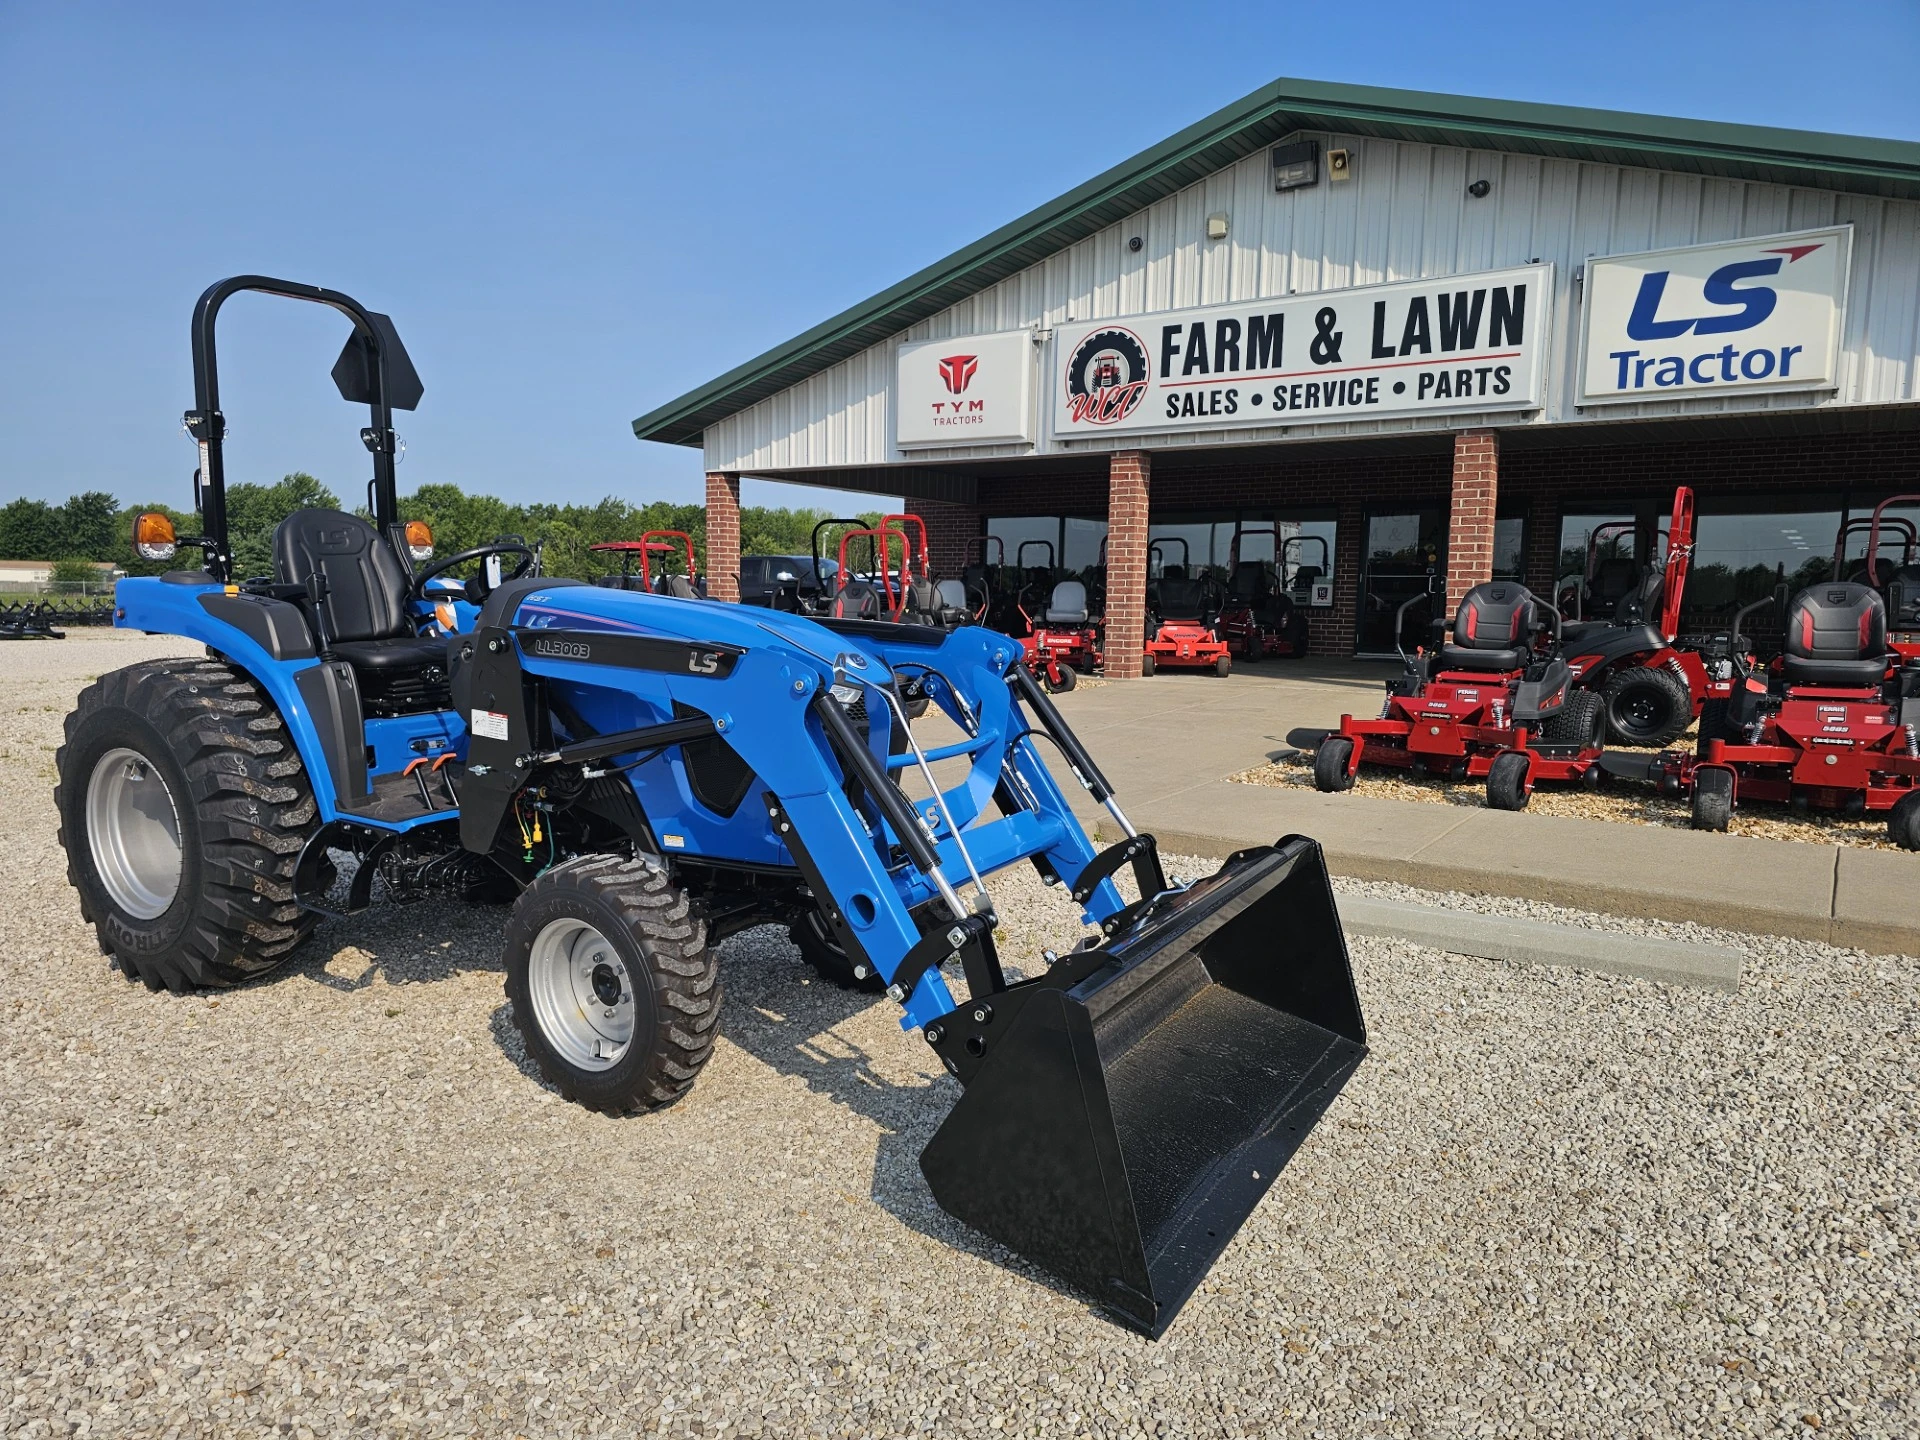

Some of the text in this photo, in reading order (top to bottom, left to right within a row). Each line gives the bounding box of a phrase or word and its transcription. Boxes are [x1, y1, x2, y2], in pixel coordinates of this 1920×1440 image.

[1626, 257, 1783, 341] LS
[1160, 284, 1527, 378] FARM & LAWN
[1610, 344, 1802, 389] Tractor
[932, 400, 984, 414] TYM
[1166, 365, 1512, 419] SALES SERVICE PARTS
[933, 415, 984, 426] TRACTORS
[536, 640, 590, 658] LL3003
[689, 651, 718, 673] LS
